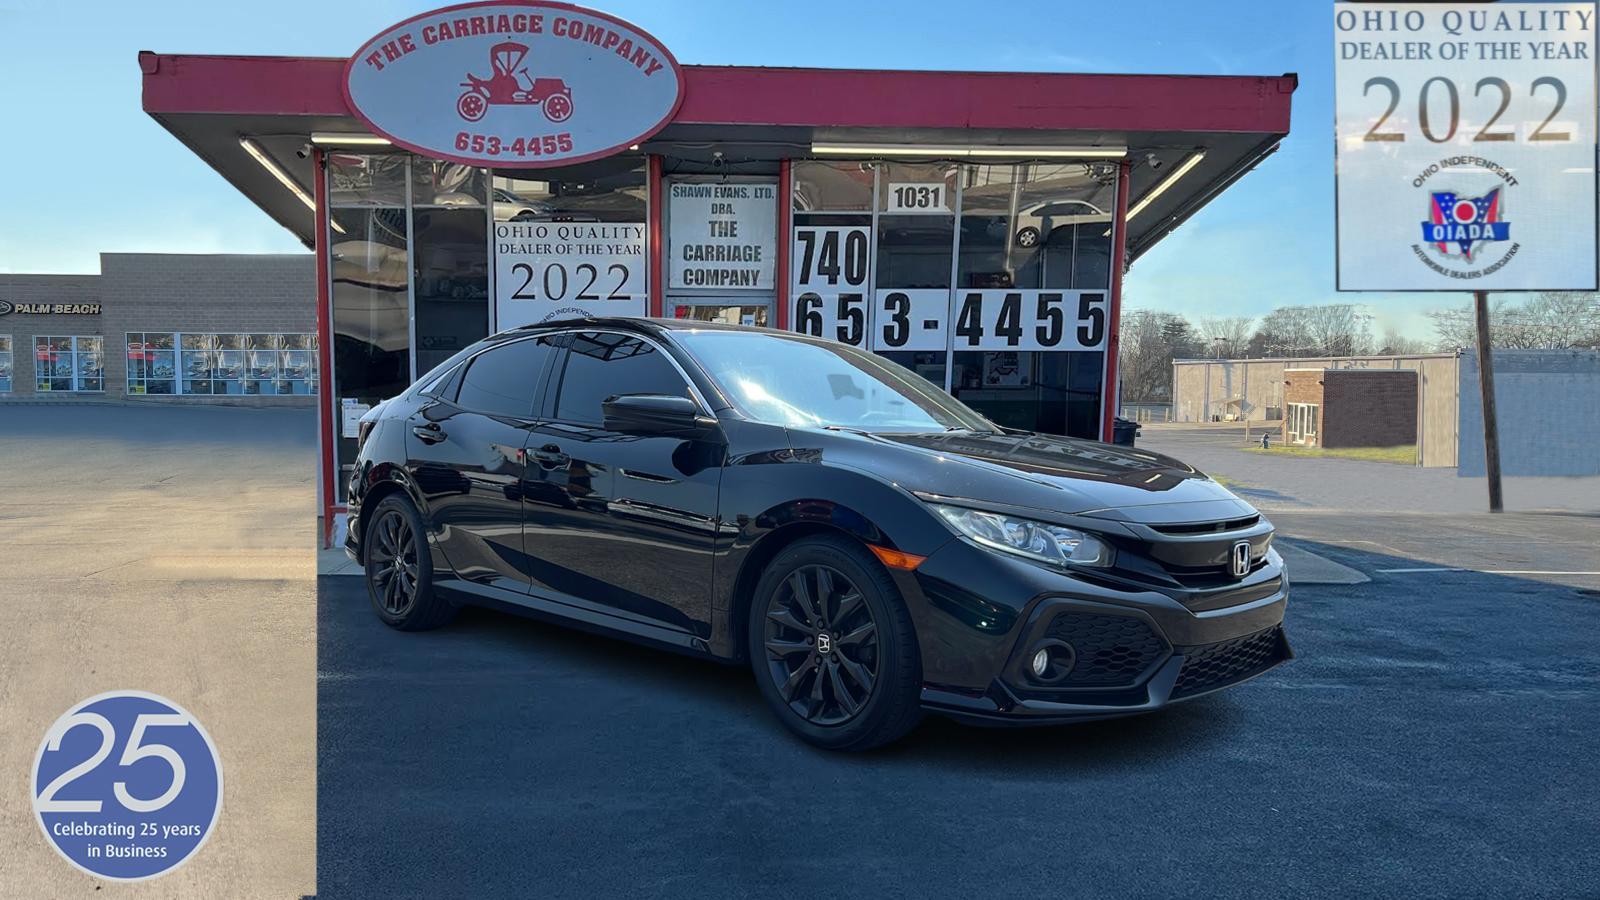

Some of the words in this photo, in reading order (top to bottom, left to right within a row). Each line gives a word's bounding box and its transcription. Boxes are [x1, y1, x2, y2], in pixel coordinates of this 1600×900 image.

[1336, 10, 1425, 31] OHIO
[1441, 10, 1593, 35] QUALITY
[365, 33, 421, 72] THE
[422, 14, 544, 46] CARRIAGE
[552, 16, 665, 77] COMPANY
[1340, 42, 1433, 60] DEALER
[1438, 42, 1469, 60] OF
[1475, 42, 1522, 60] THE
[1528, 42, 1589, 60] YEAR
[1362, 76, 1571, 143] 2022
[454, 131, 574, 157] 653-4455
[1412, 163, 1440, 188] OHIO
[1440, 156, 1519, 187] INDEPENDENT
[672, 186, 713, 199] SHAWN
[754, 187, 775, 200] LTD.
[894, 186, 941, 209] 1031
[711, 203, 736, 215] DBA.
[496, 225, 549, 239] OHIO
[557, 225, 646, 241] QUALITY
[708, 220, 738, 238] THE
[1432, 223, 1496, 241] OIADA
[499, 243, 552, 255] DEALER
[556, 243, 575, 255] OF
[576, 243, 603, 255] THE
[605, 243, 642, 255] YEAR
[683, 244, 763, 262] CARRIAGE
[797, 230, 867, 286] 740
[510, 262, 632, 301] 2022
[683, 268, 760, 286] COMPANY
[14, 303, 51, 314] PALM
[54, 304, 101, 315] BEACH
